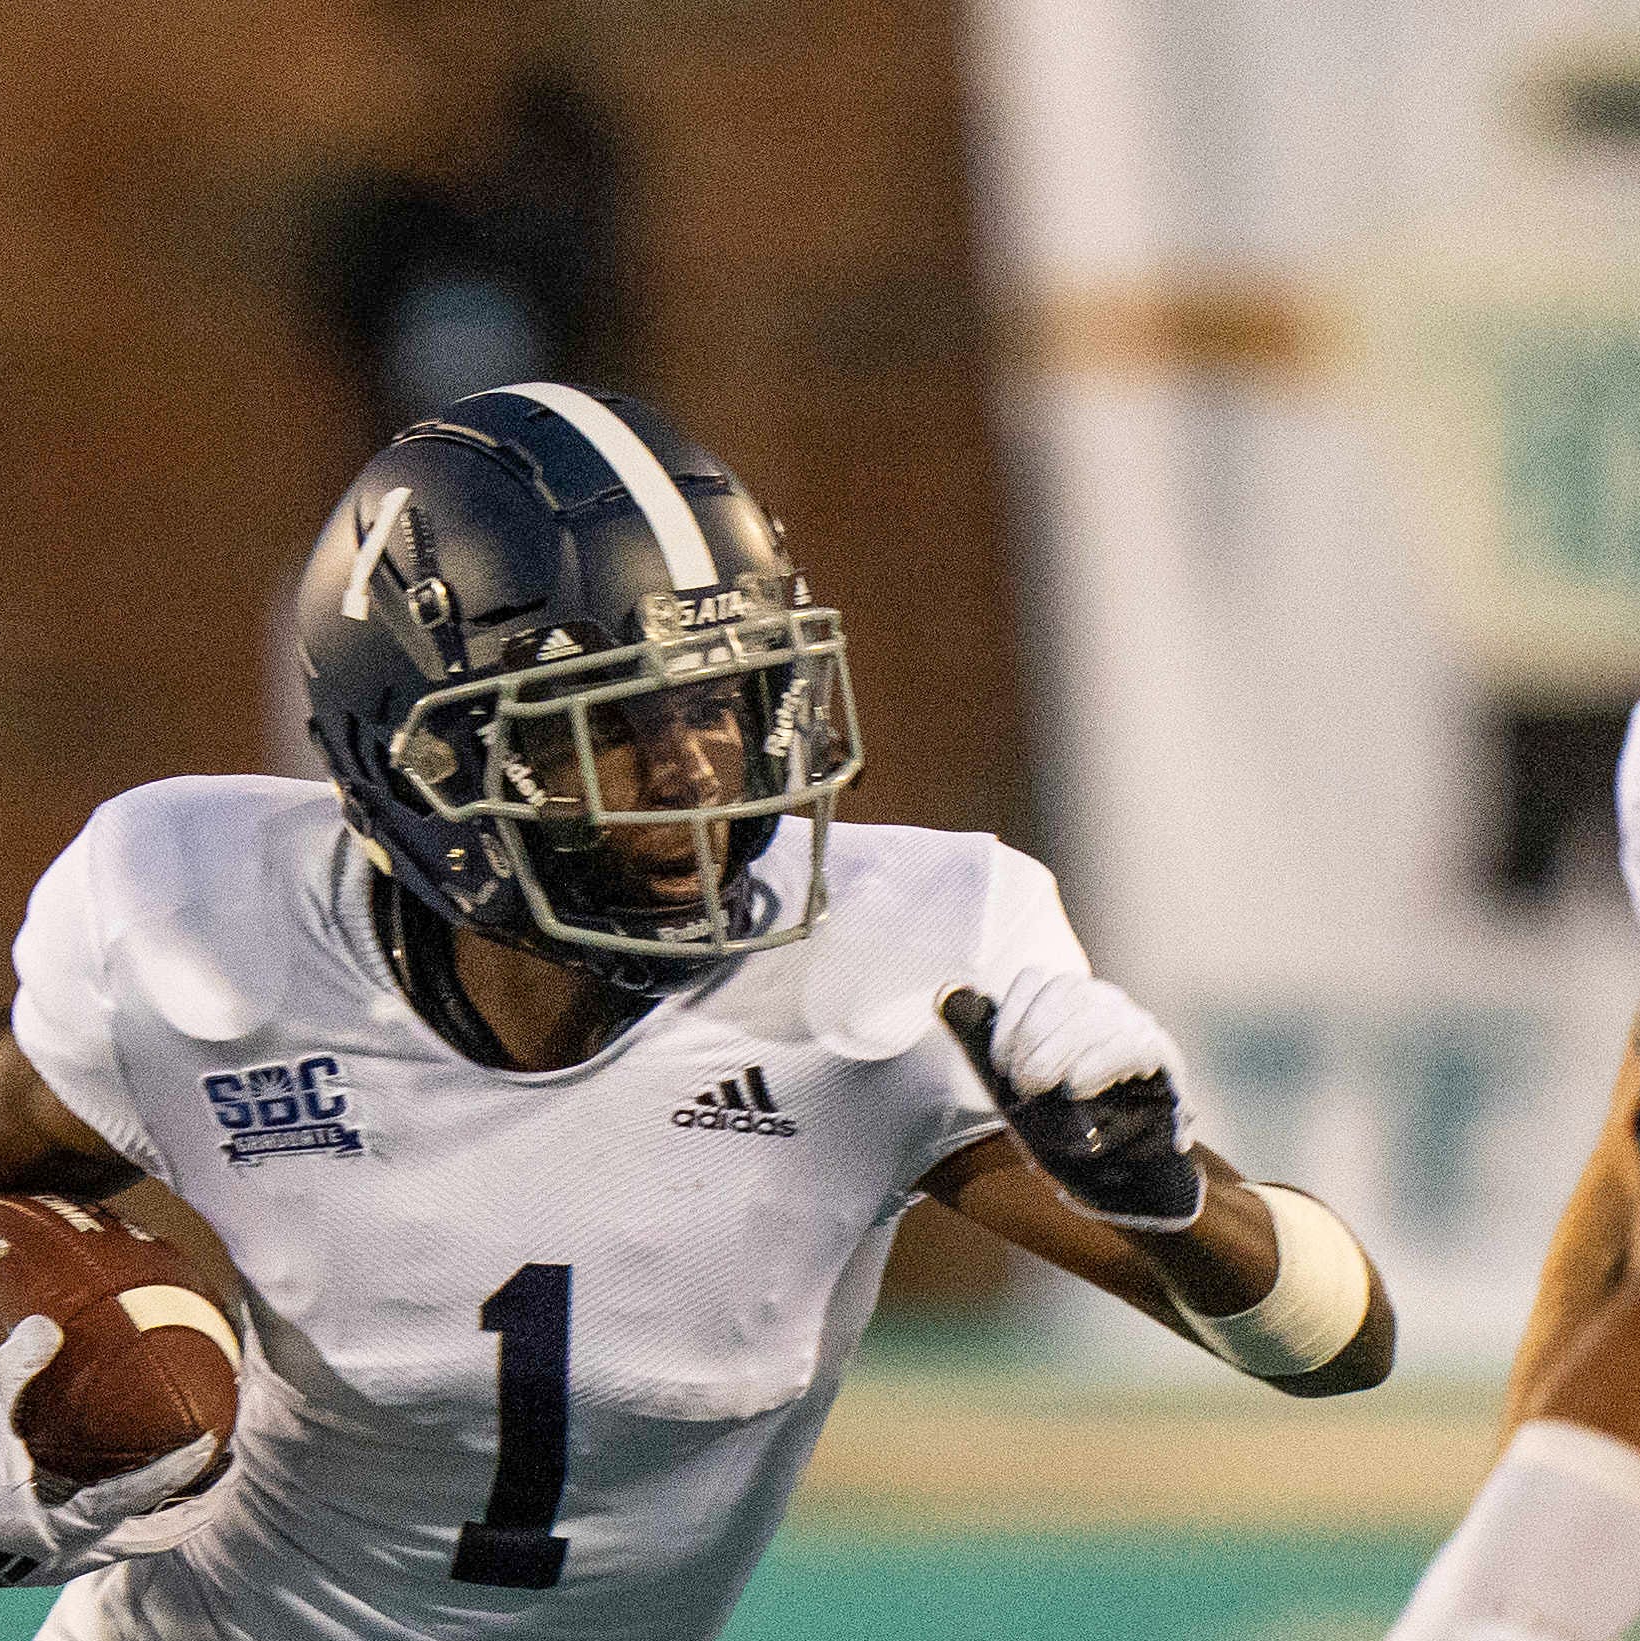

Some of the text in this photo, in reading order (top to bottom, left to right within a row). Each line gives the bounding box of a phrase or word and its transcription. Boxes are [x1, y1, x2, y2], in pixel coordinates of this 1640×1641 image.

[204, 1056, 349, 1130] SBC
[671, 1104, 797, 1137] adidas
[450, 1263, 574, 1589] 1
